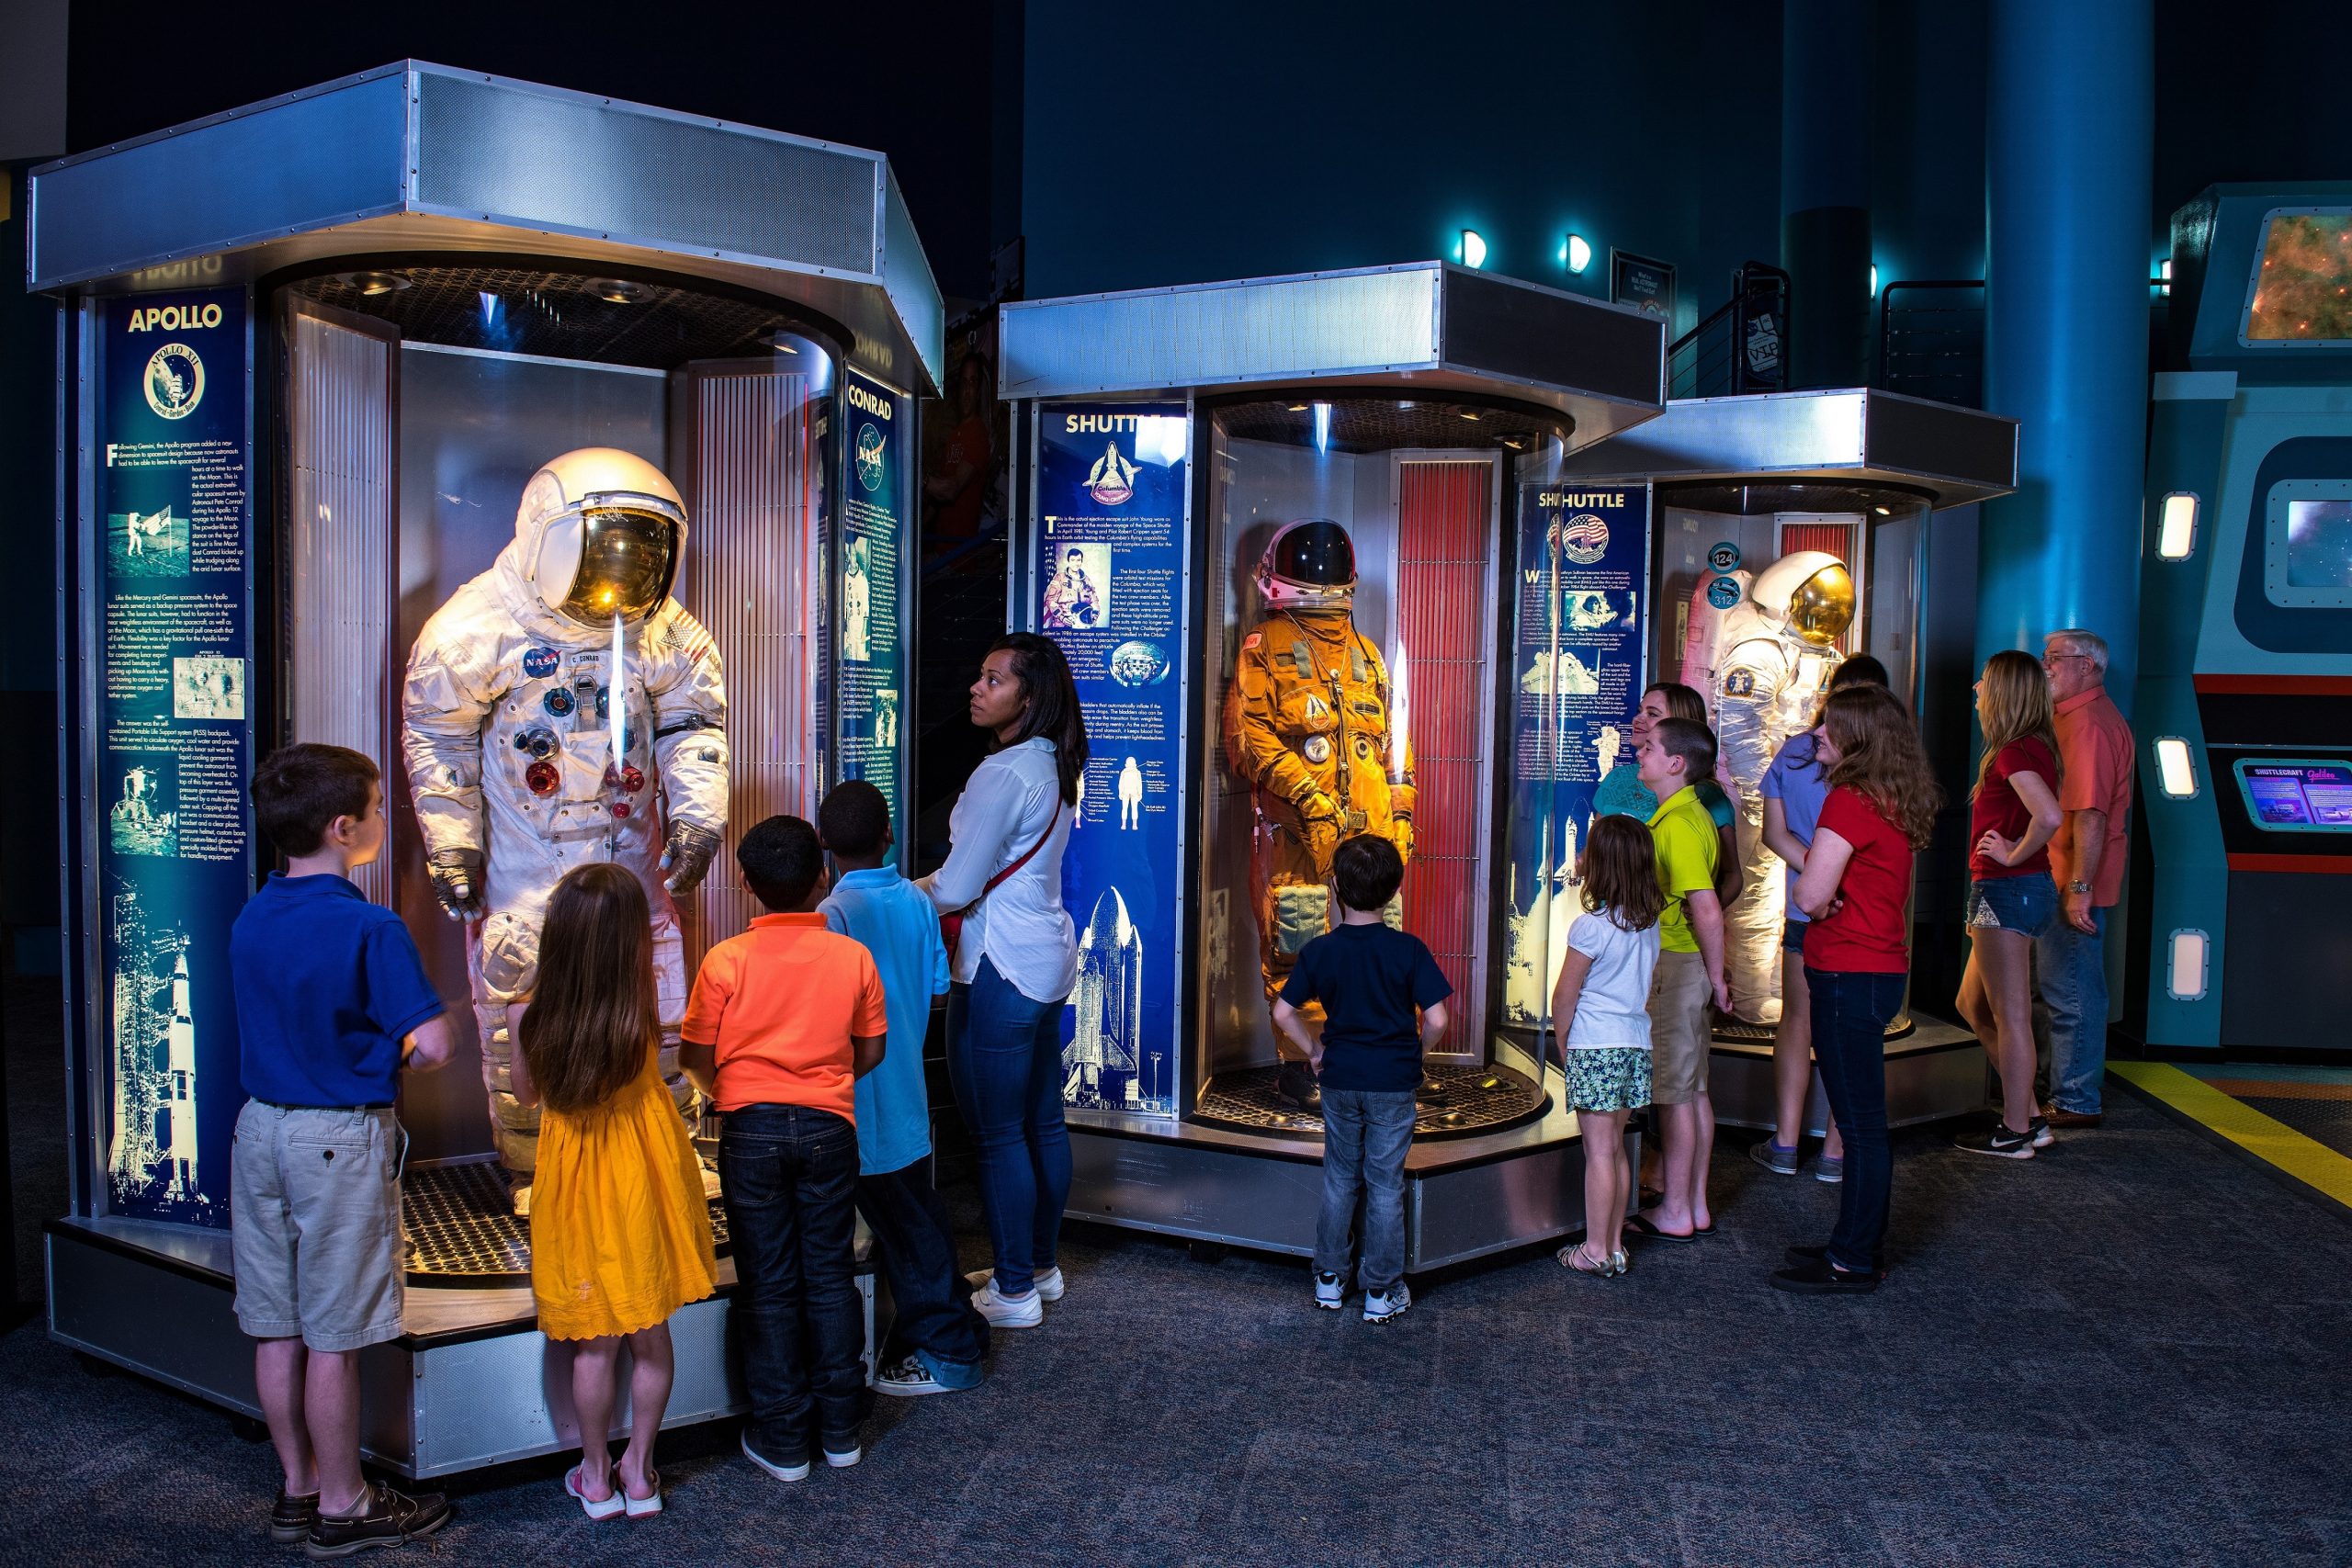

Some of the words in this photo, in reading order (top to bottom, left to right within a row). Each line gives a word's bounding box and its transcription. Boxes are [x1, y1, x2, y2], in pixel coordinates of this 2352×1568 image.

[128, 304, 222, 332] APOLLO
[151, 346, 183, 368] APOLLO
[186, 350, 200, 365] XII
[1750, 342, 1778, 361] VIP
[153, 402, 167, 416] Conrad
[169, 409, 184, 417] Gordon
[185, 401, 195, 412] Bean
[848, 385, 891, 421] CONRAD
[1066, 414, 1161, 433] SHUTT
[859, 446, 882, 467] NASA
[1095, 492, 1109, 502] YOUNG
[1110, 492, 1129, 502] CRIPPEN
[1715, 554, 1732, 563] 124
[1715, 596, 1732, 605] 312
[527, 657, 558, 666] NASA
[179, 770, 201, 778] becoming
[2307, 769, 2335, 782] Galileo
